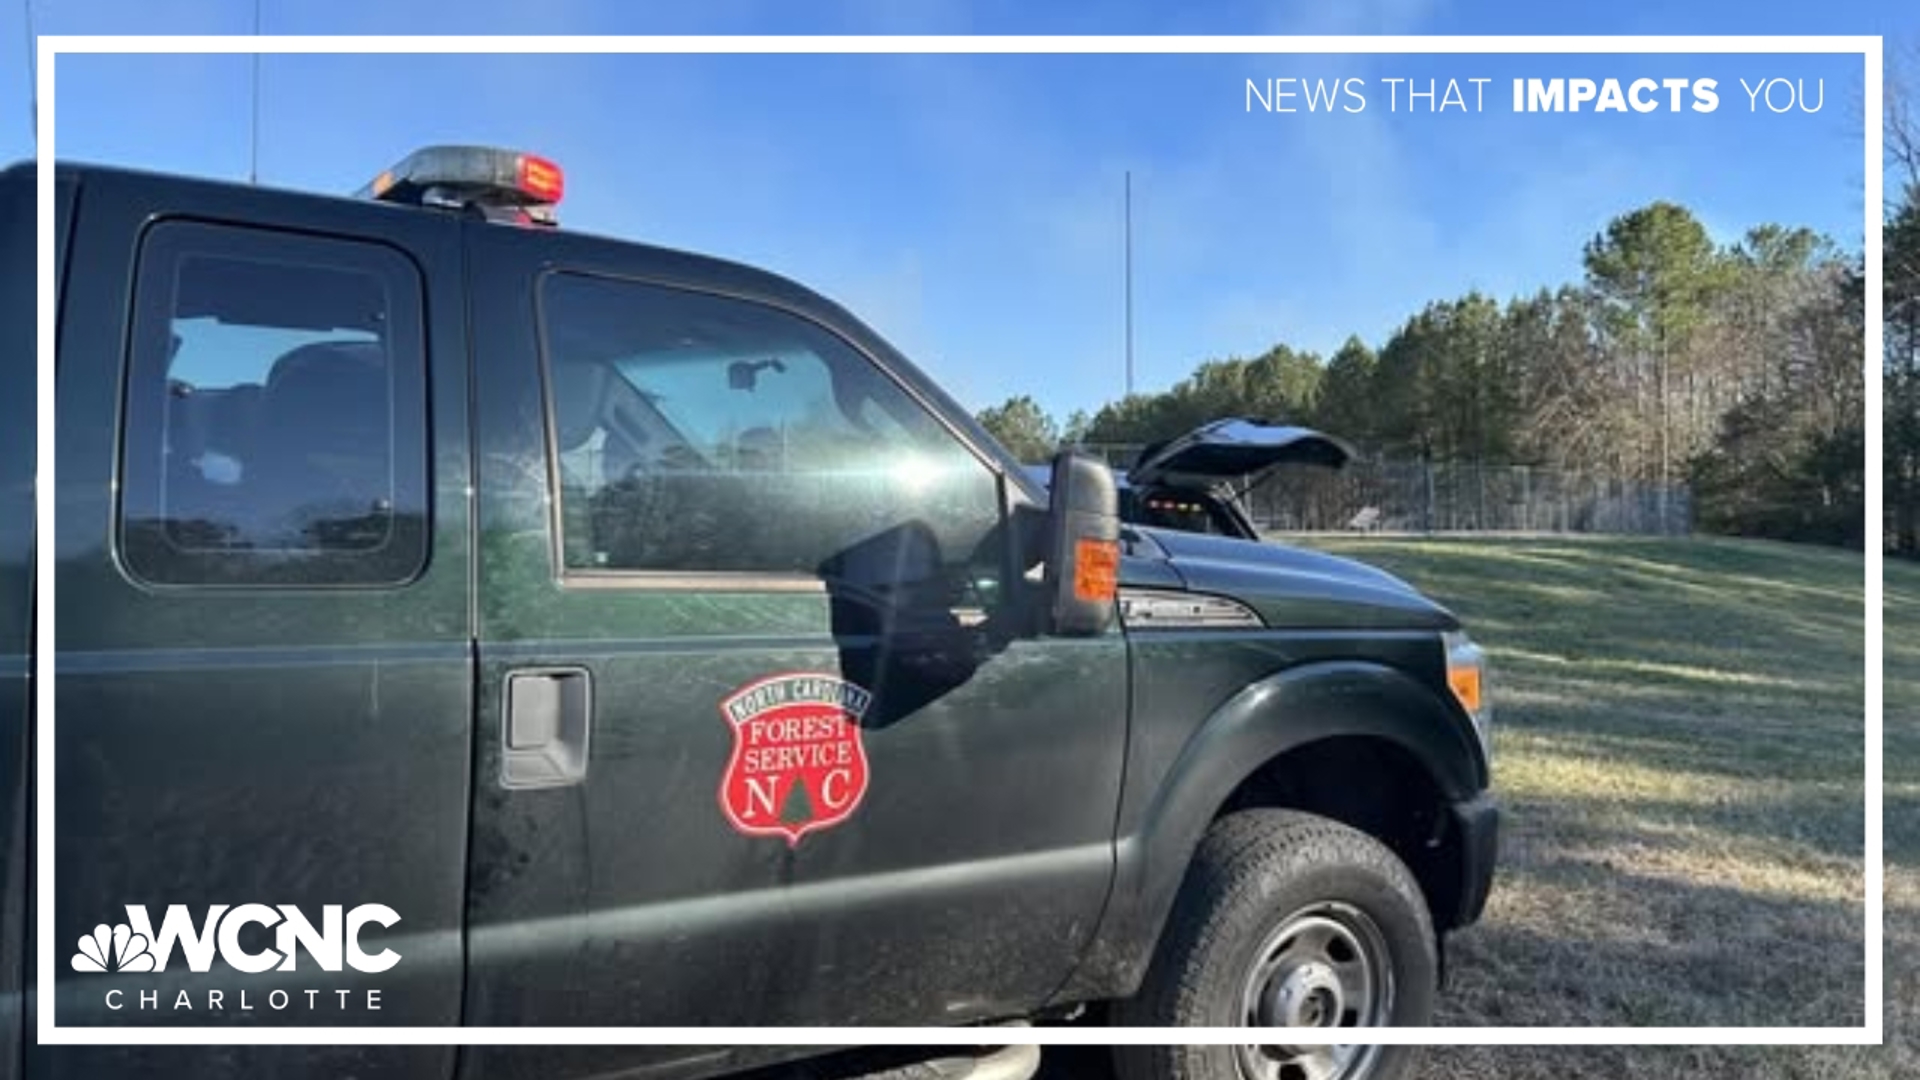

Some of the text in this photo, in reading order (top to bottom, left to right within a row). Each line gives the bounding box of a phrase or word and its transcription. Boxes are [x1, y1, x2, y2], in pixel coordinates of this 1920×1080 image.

[731, 682, 785, 718] NORTH
[751, 715, 847, 744] FOREST
[744, 741, 852, 773] SERVICE
